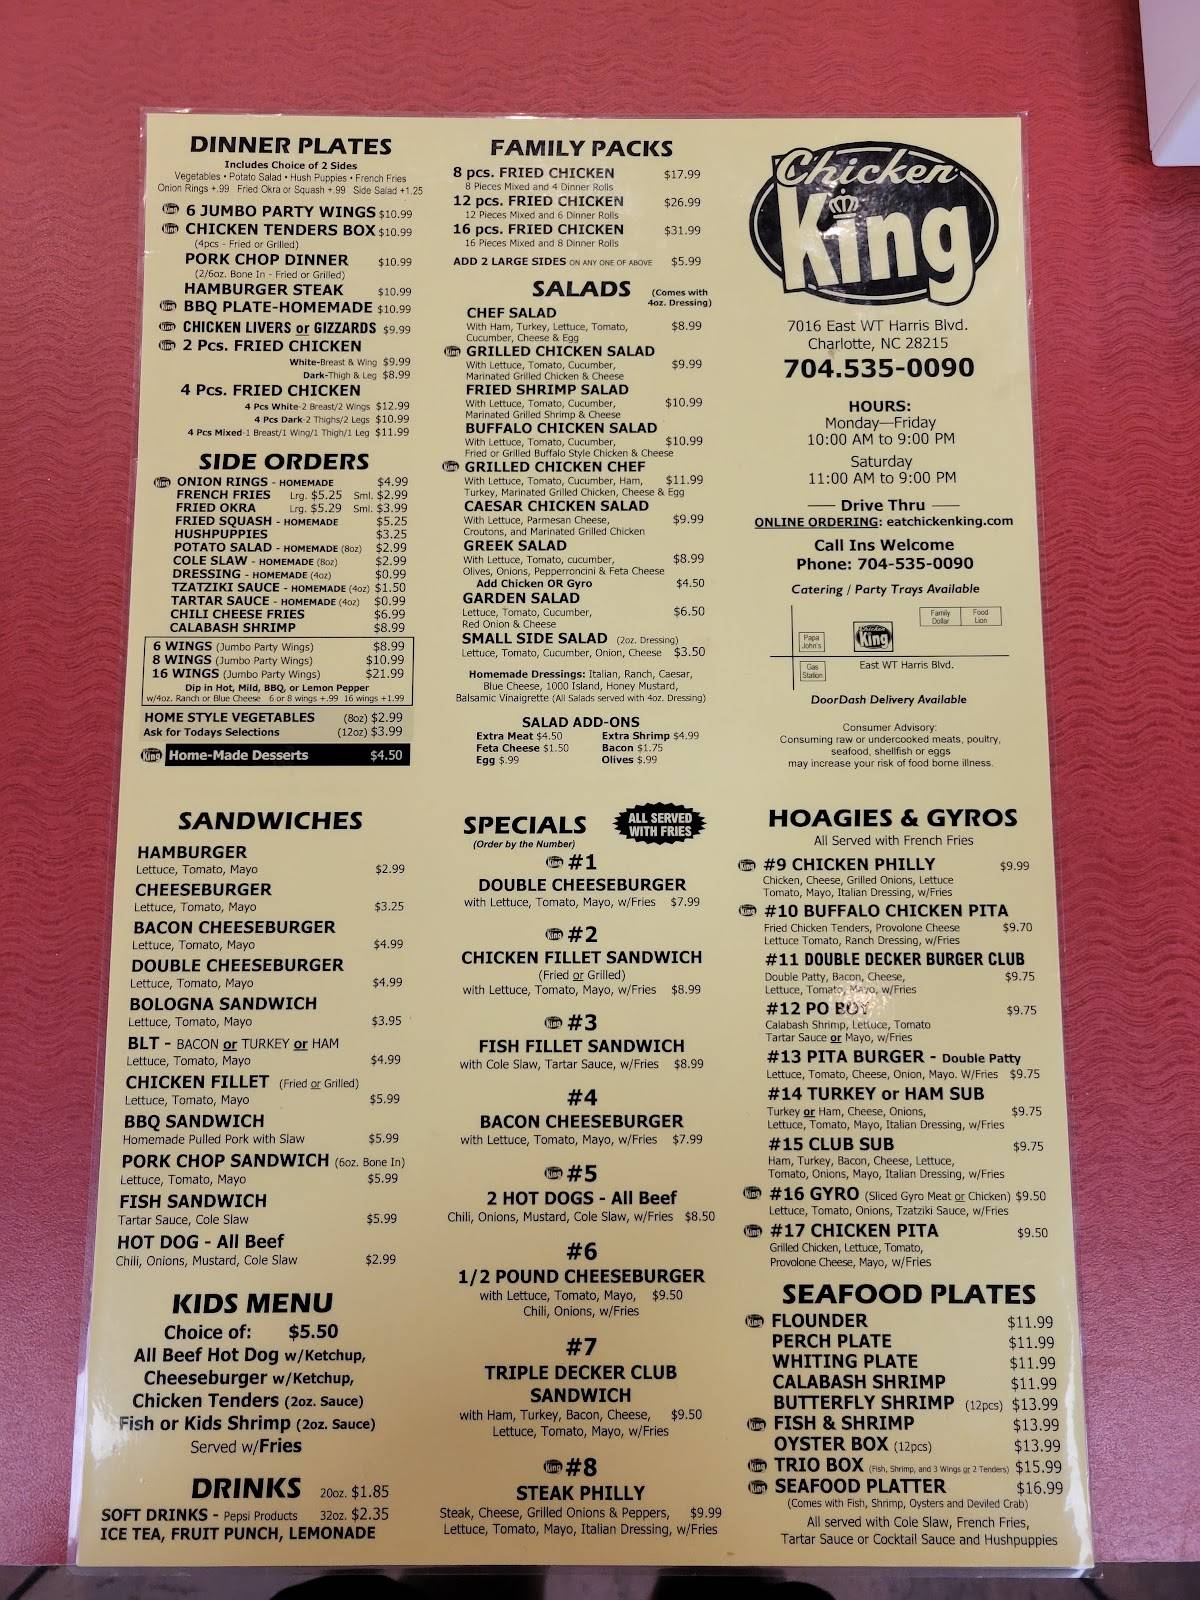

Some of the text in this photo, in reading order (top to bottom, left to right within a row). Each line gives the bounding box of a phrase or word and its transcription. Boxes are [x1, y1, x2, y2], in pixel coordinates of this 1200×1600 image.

[190, 136, 393, 155] DINNER PLATES
[490, 139, 673, 157] FAMILY PACKS
[272, 161, 305, 169] Choice
[331, 162, 357, 170] Sides
[776, 146, 960, 186] Chicken
[175, 172, 220, 182] Vegetables
[230, 172, 255, 181] Potato
[259, 173, 281, 181] Salad
[315, 174, 346, 183] Puppies
[356, 174, 383, 182] French
[387, 174, 406, 182] Fries
[454, 167, 700, 180] 8 pcs. FRIED CHICKEN $17.99
[466, 182, 470, 190] 8
[475, 182, 501, 190] Pieces
[552, 183, 558, 191] 4
[187, 205, 412, 219] 6 JUMBO PARTY WINGS $10.99
[776, 185, 974, 304] King
[186, 253, 412, 267] PORK CHOP DINNER $10.99
[533, 280, 630, 297] SALADS
[467, 308, 556, 318] CHEF SALAD
[490, 323, 513, 332] Ham,
[516, 323, 549, 332] Turkey,
[554, 323, 588, 332] Lettuce,
[592, 323, 627, 332] Tomato,
[672, 321, 701, 331] $8.99
[788, 319, 968, 332] 7016 East WT Harris Blvd.
[784, 357, 975, 379] 704.535-0090
[850, 400, 910, 412] HOURS:
[199, 453, 370, 470] SIDE ORDERS
[809, 472, 956, 484] 11:00 AM to 9:00 PM
[177, 490, 228, 499] FRENCH
[233, 490, 270, 499] FRIES
[291, 492, 307, 501] Lrg.
[312, 490, 342, 501] $5.25
[378, 490, 407, 501] $2.99
[754, 516, 1013, 528] ONLINE ORDERING: eatchickenking.com
[175, 529, 406, 540] HUSHPUPPIES $3.25
[463, 567, 664, 577] Olives, Onions, Pepperroncini & Feta Cheese
[972, 608, 989, 616] Food
[803, 634, 820, 642] Papa
[153, 668, 404, 680] 16 WINGS (Jumbo Party Wings) $21.99
[811, 695, 966, 706] DoorDash Delivery Available
[522, 717, 640, 728] SALAD ADD-ONS
[170, 750, 402, 760] Home-Made Desserts $4.50
[477, 756, 519, 766] Egg $.99
[602, 756, 657, 765] Olives $.99
[789, 760, 808, 769] may
[812, 759, 850, 767] increase
[854, 760, 874, 769] your
[877, 759, 893, 767] risk
[897, 759, 906, 767] of
[908, 759, 928, 767] food
[962, 759, 993, 767] illness.
[179, 812, 362, 830] SANDWICHES
[628, 813, 692, 824] ALL SERVED
[769, 809, 1017, 827] HOAGIES & GYROS
[463, 816, 587, 834] SPECIALS
[629, 825, 692, 837] WITH FRIES
[138, 846, 247, 858] HAMBURGER
[568, 853, 597, 870] #1
[764, 858, 1029, 872] #9 CHICKEN PHILLY $9.99
[136, 864, 404, 876] Lettuce, Tomato, Mayo $2.99
[478, 878, 687, 892] DOUBLE CHEESEBURGER
[125, 1114, 264, 1132] BBQ SANDWICH
[783, 1284, 1036, 1304] SEAFOOD PLATES
[172, 1293, 334, 1314] KIDS MENU
[772, 1314, 1053, 1330] FLOUNDER $11.99
[164, 1324, 339, 1341] Choice of: $5.50
[192, 1477, 302, 1499] DRINKS
[516, 1485, 645, 1501] STEAK PHILLY
[788, 1498, 1028, 1510] (Comes with Fish, Shrimp, Oysters and Deviled Crab)
